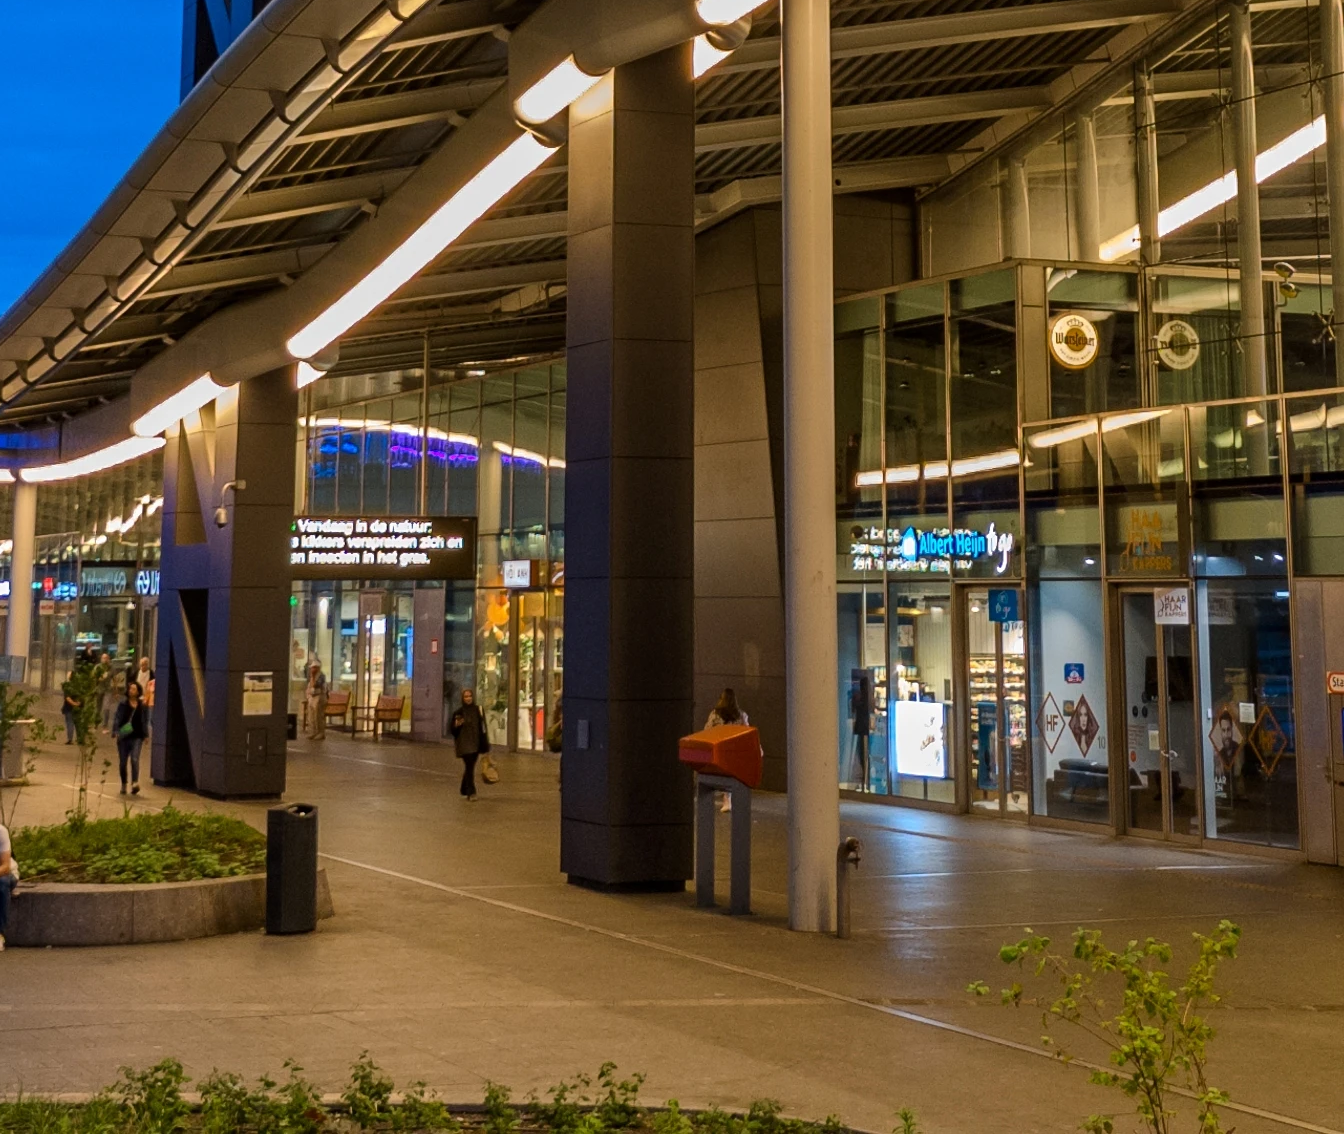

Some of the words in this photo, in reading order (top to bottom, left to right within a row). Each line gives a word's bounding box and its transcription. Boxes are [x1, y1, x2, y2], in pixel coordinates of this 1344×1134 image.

[297, 518, 354, 536] Vandaag
[355, 519, 368, 533] in
[369, 519, 388, 533] de
[419, 535, 445, 549] zich
[446, 537, 464, 549] en
[919, 532, 954, 556] Albert
[956, 530, 986, 558] Heijn
[362, 551, 375, 564] in
[376, 551, 398, 564] het
[1164, 595, 1187, 603] HAAR
[1046, 714, 1058, 732] HF
